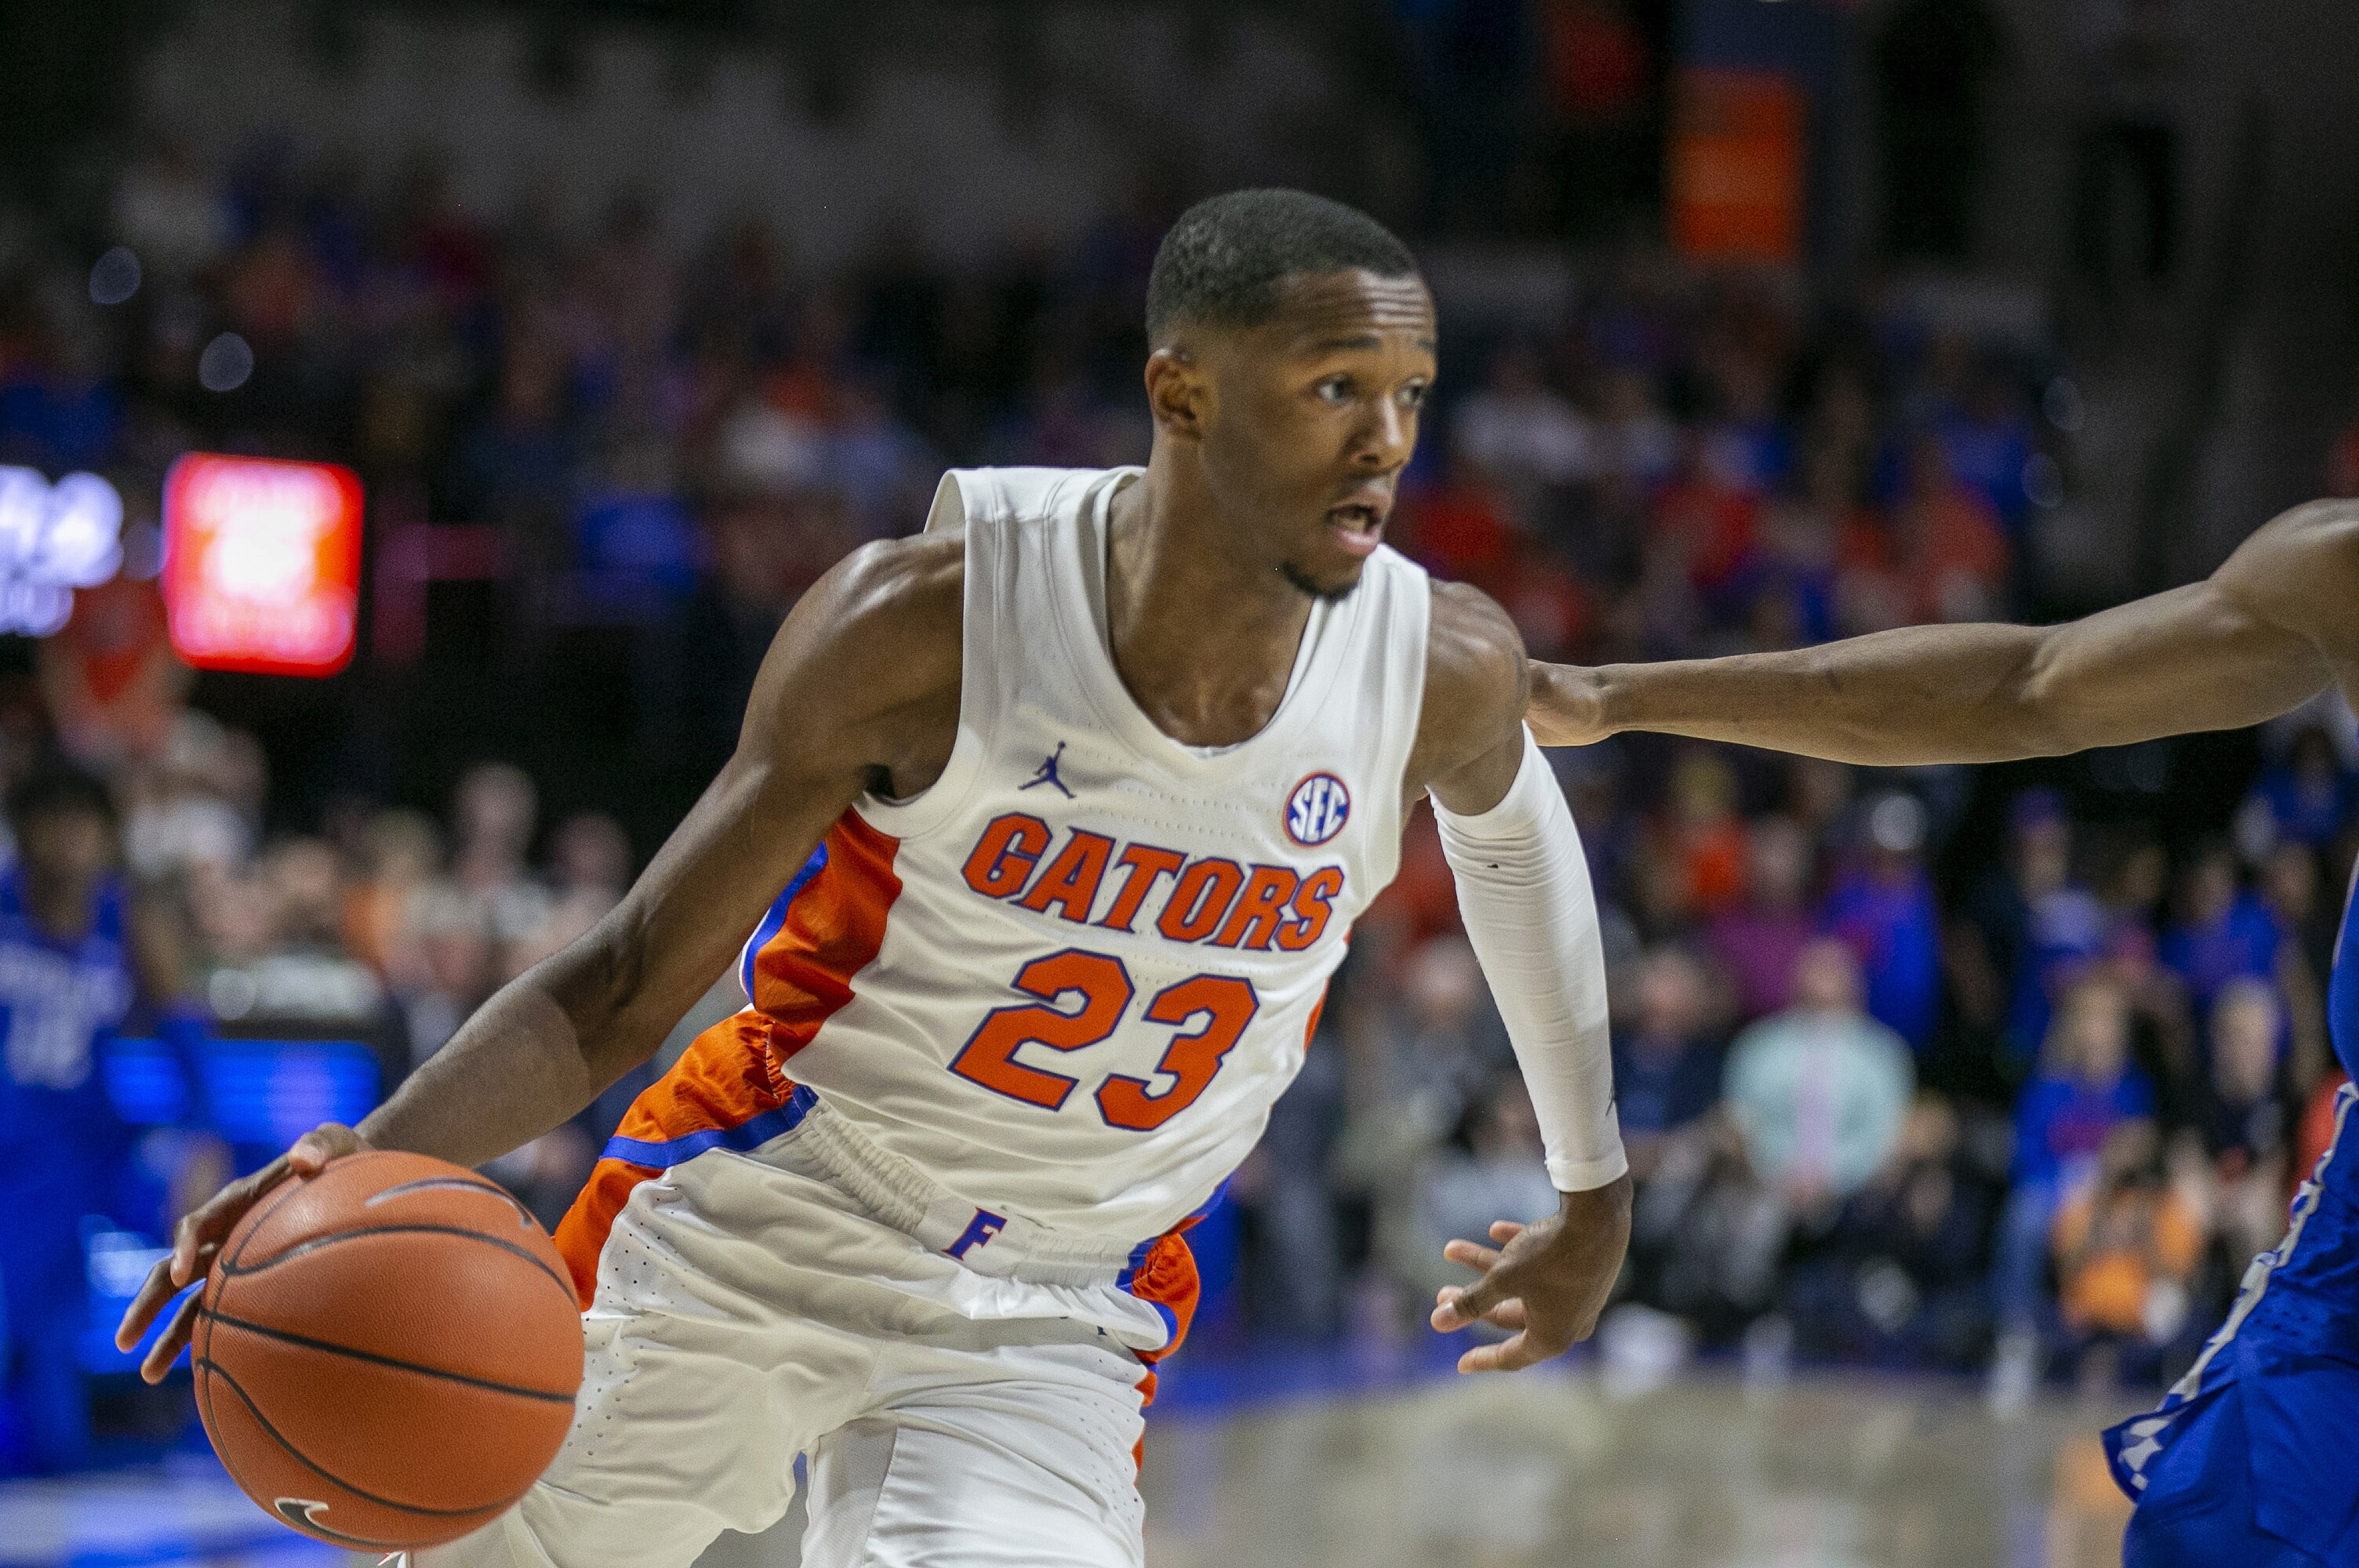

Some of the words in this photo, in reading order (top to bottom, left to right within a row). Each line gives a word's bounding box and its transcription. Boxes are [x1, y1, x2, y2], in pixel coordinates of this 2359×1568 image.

[1288, 775, 1347, 842] SEC
[961, 812, 1344, 952] GATORS
[947, 947, 1259, 1131] 23
[943, 1207, 1007, 1261] F
